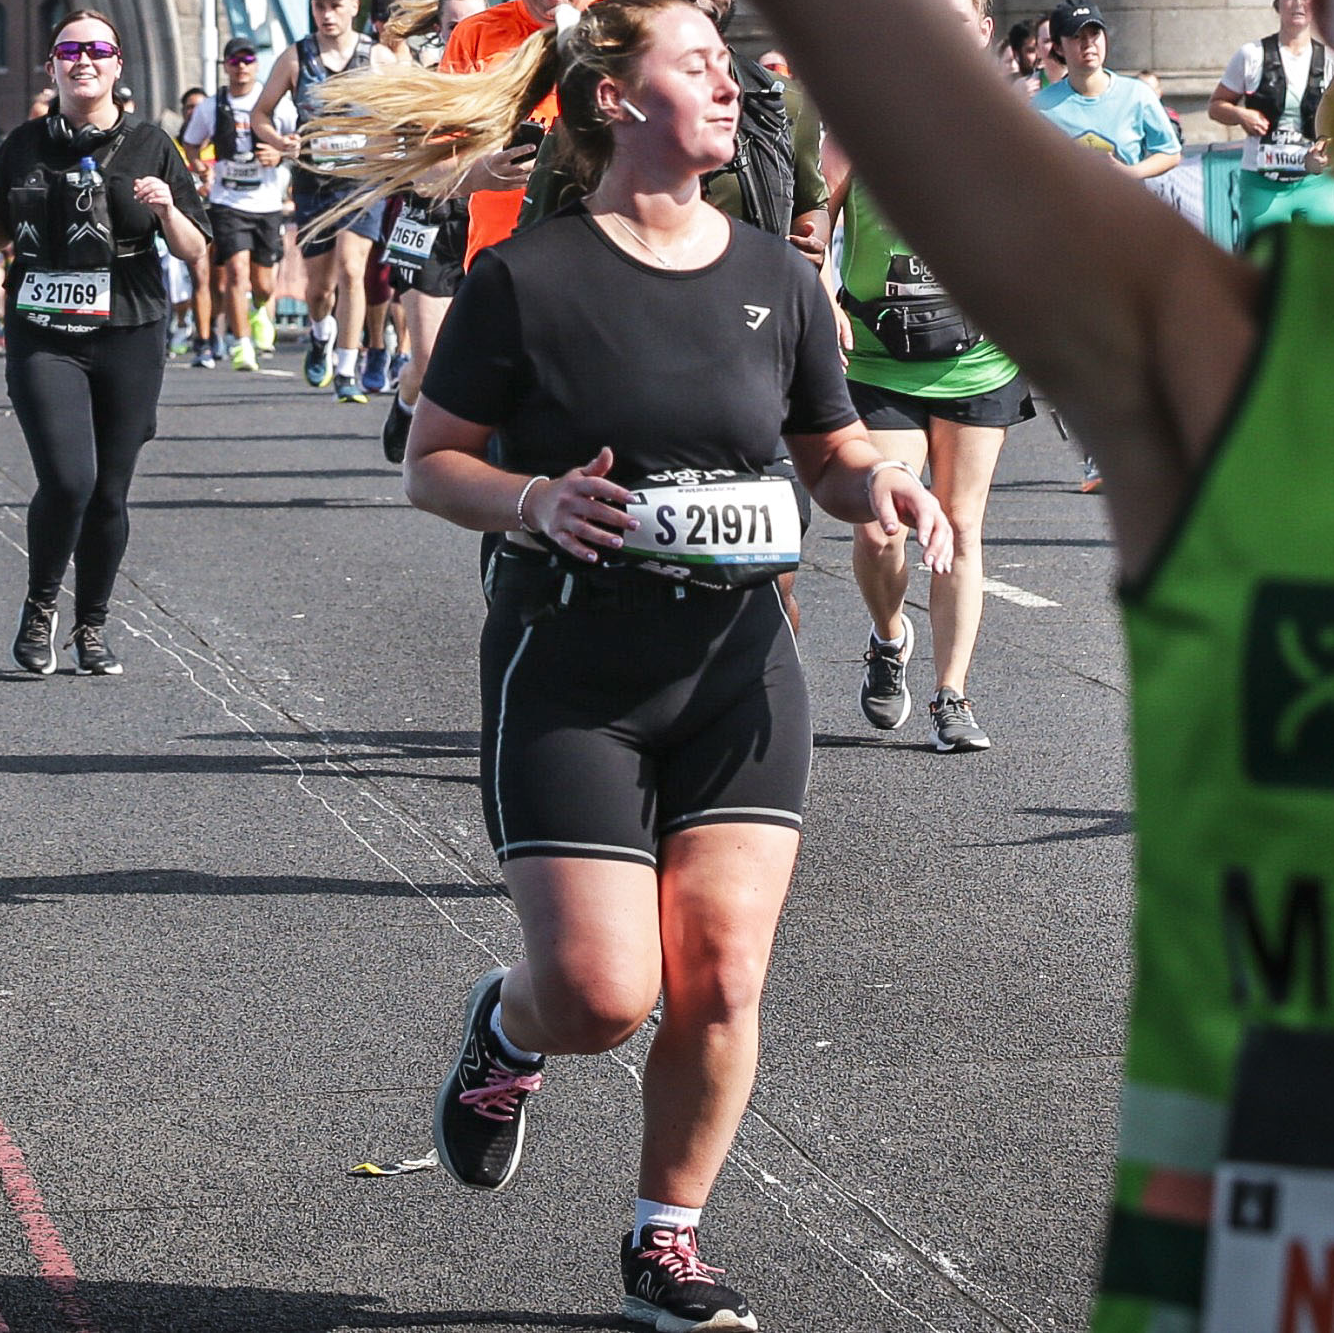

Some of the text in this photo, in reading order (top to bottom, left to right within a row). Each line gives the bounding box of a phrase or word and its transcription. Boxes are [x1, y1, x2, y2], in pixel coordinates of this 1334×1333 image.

[31, 282, 97, 305] S 21769
[655, 504, 773, 546] S 21971
